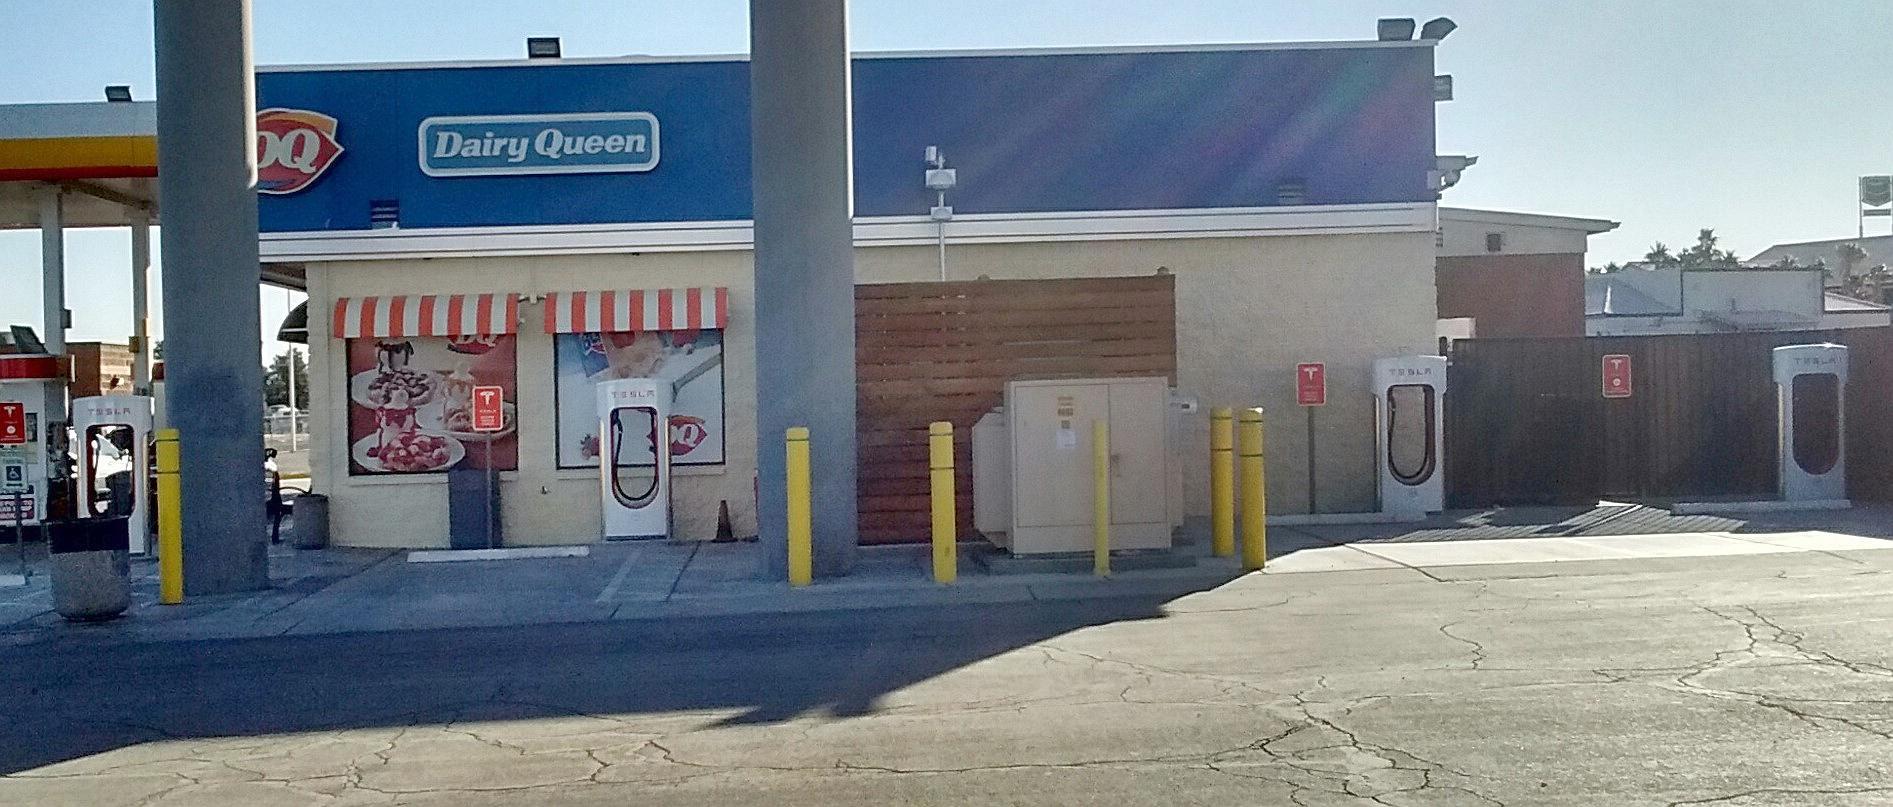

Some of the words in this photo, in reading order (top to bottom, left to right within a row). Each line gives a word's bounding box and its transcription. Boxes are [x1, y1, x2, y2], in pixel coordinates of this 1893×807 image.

[434, 131, 529, 163] Dairy
[534, 128, 646, 158] Queen
[1389, 368, 1432, 376] TESLA
[612, 390, 655, 398] TESLA
[88, 408, 131, 416] TESLA
